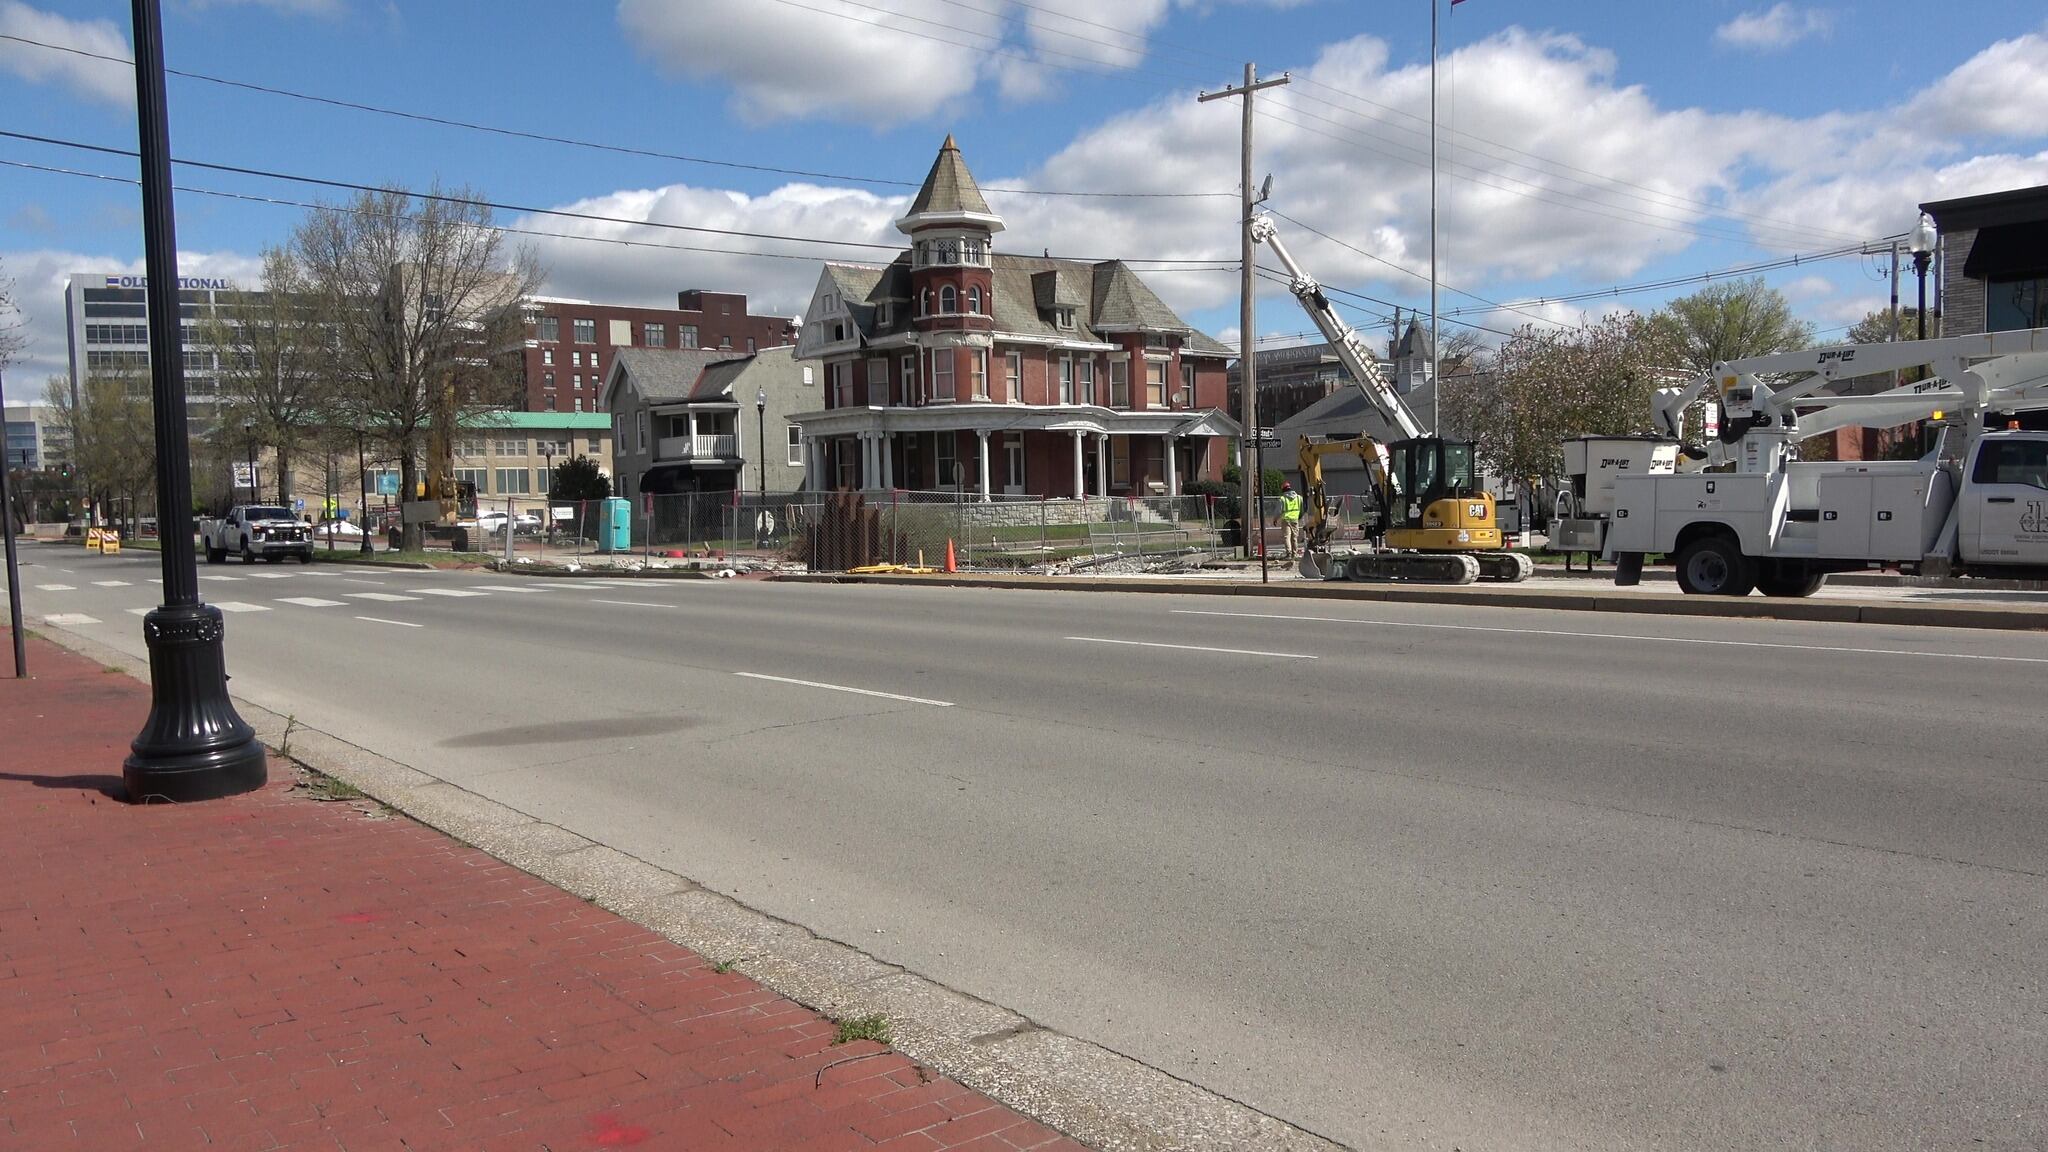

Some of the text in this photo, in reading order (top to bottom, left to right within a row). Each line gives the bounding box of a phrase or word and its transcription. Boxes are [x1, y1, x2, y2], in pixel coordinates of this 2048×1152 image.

[178, 278, 229, 289] TIONAL
[1817, 350, 1855, 363] DUR-A-LIFT
[1600, 459, 1630, 469] DUR-A-LIFT
[1469, 504, 1485, 517] CAT
